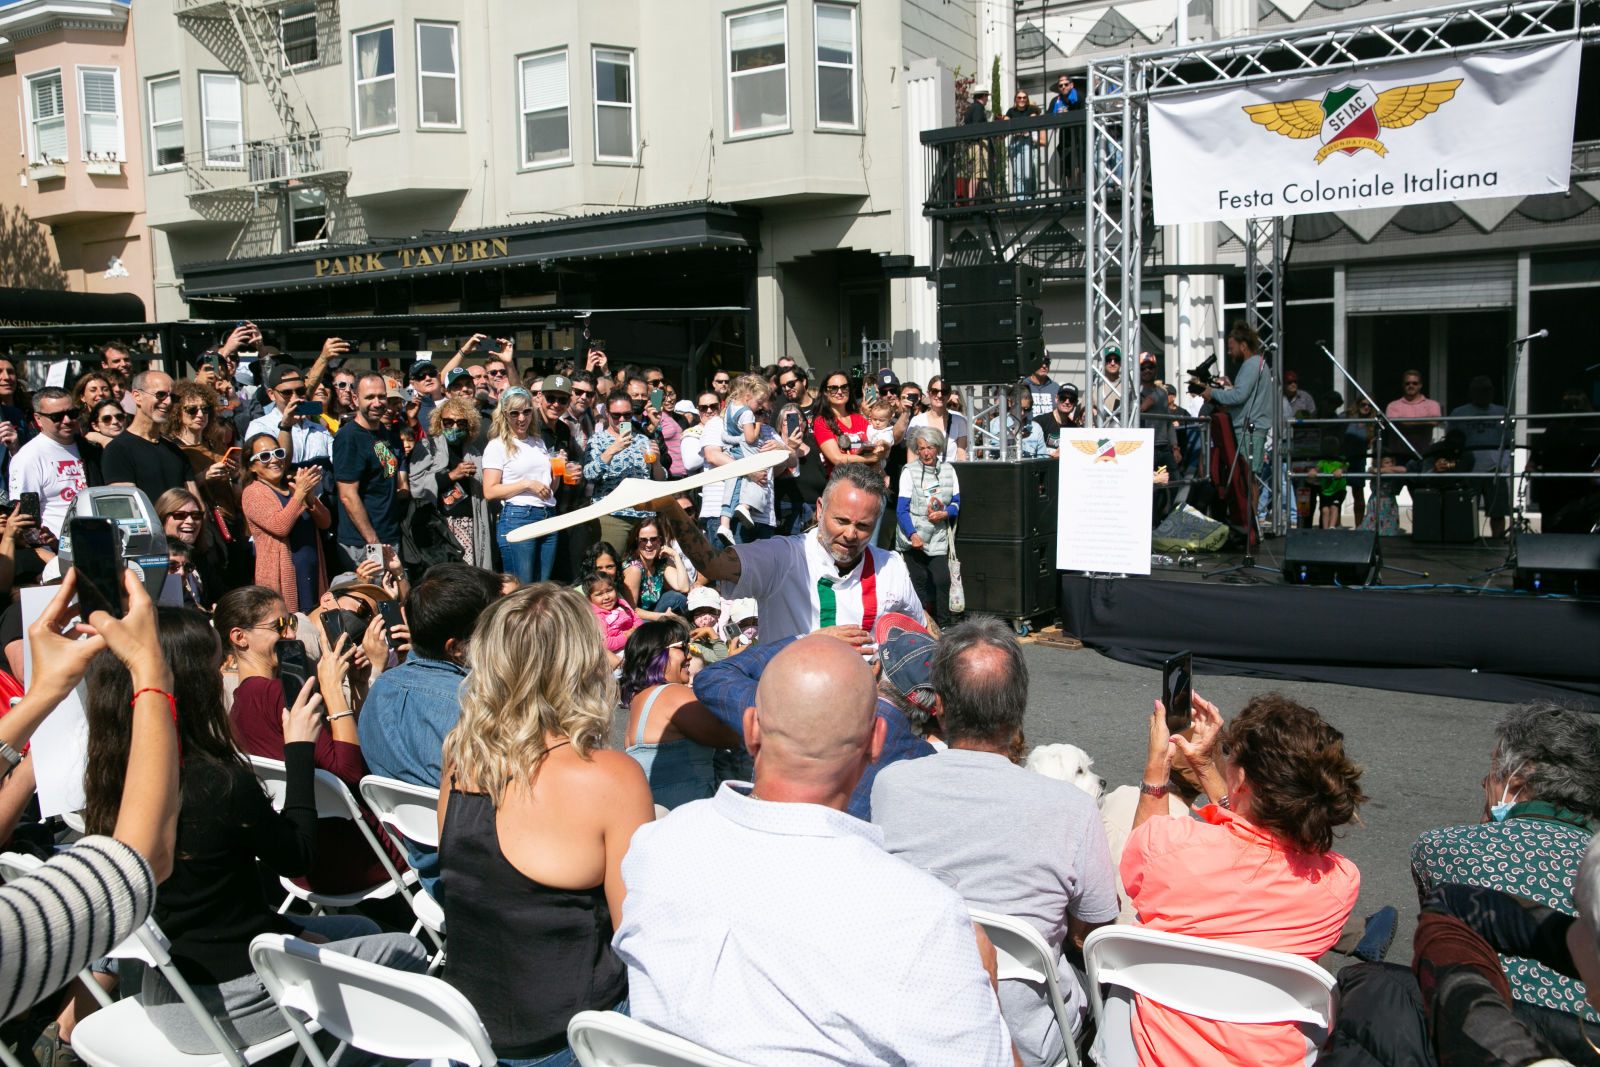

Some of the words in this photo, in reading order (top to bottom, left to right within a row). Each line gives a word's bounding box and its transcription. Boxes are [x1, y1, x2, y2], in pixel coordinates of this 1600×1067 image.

[1328, 96, 1367, 132] SFIAC
[1322, 139, 1379, 154] FOUNDATION
[1218, 190, 1273, 210] Festa
[1282, 174, 1395, 204] Coloniale
[1404, 168, 1498, 194] Italiana
[314, 252, 386, 278] PARK
[398, 236, 510, 269] TAVERN
